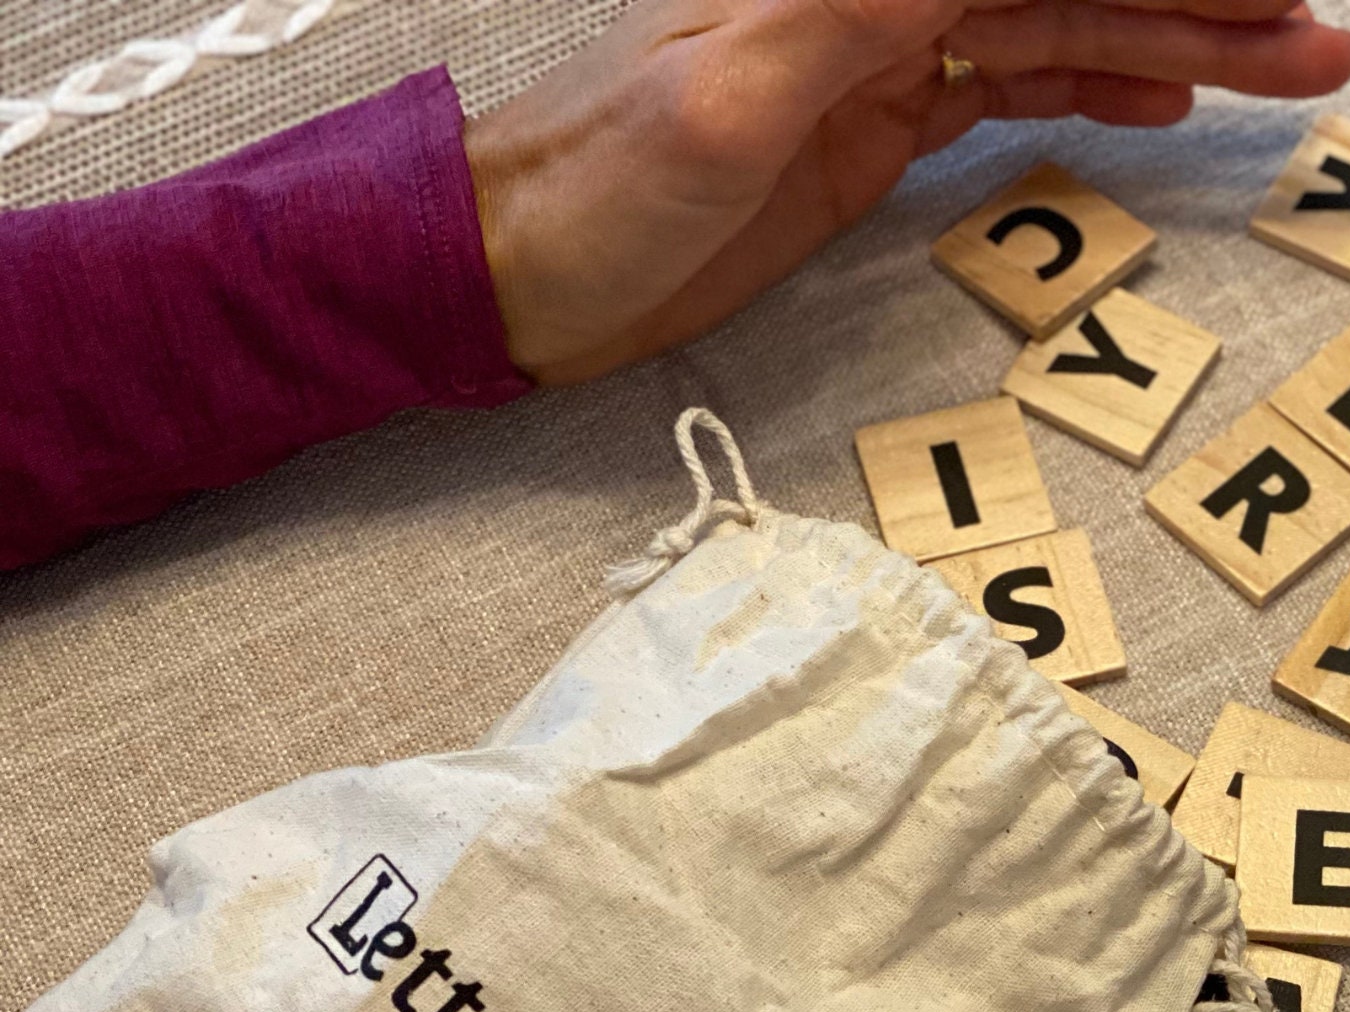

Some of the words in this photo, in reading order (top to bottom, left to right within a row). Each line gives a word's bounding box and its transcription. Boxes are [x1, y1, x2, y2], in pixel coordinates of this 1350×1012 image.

[986, 206, 1083, 283] C
[1046, 310, 1158, 390] Y
[929, 440, 981, 529] I
[1200, 446, 1311, 555] R
[983, 566, 1066, 661] S
